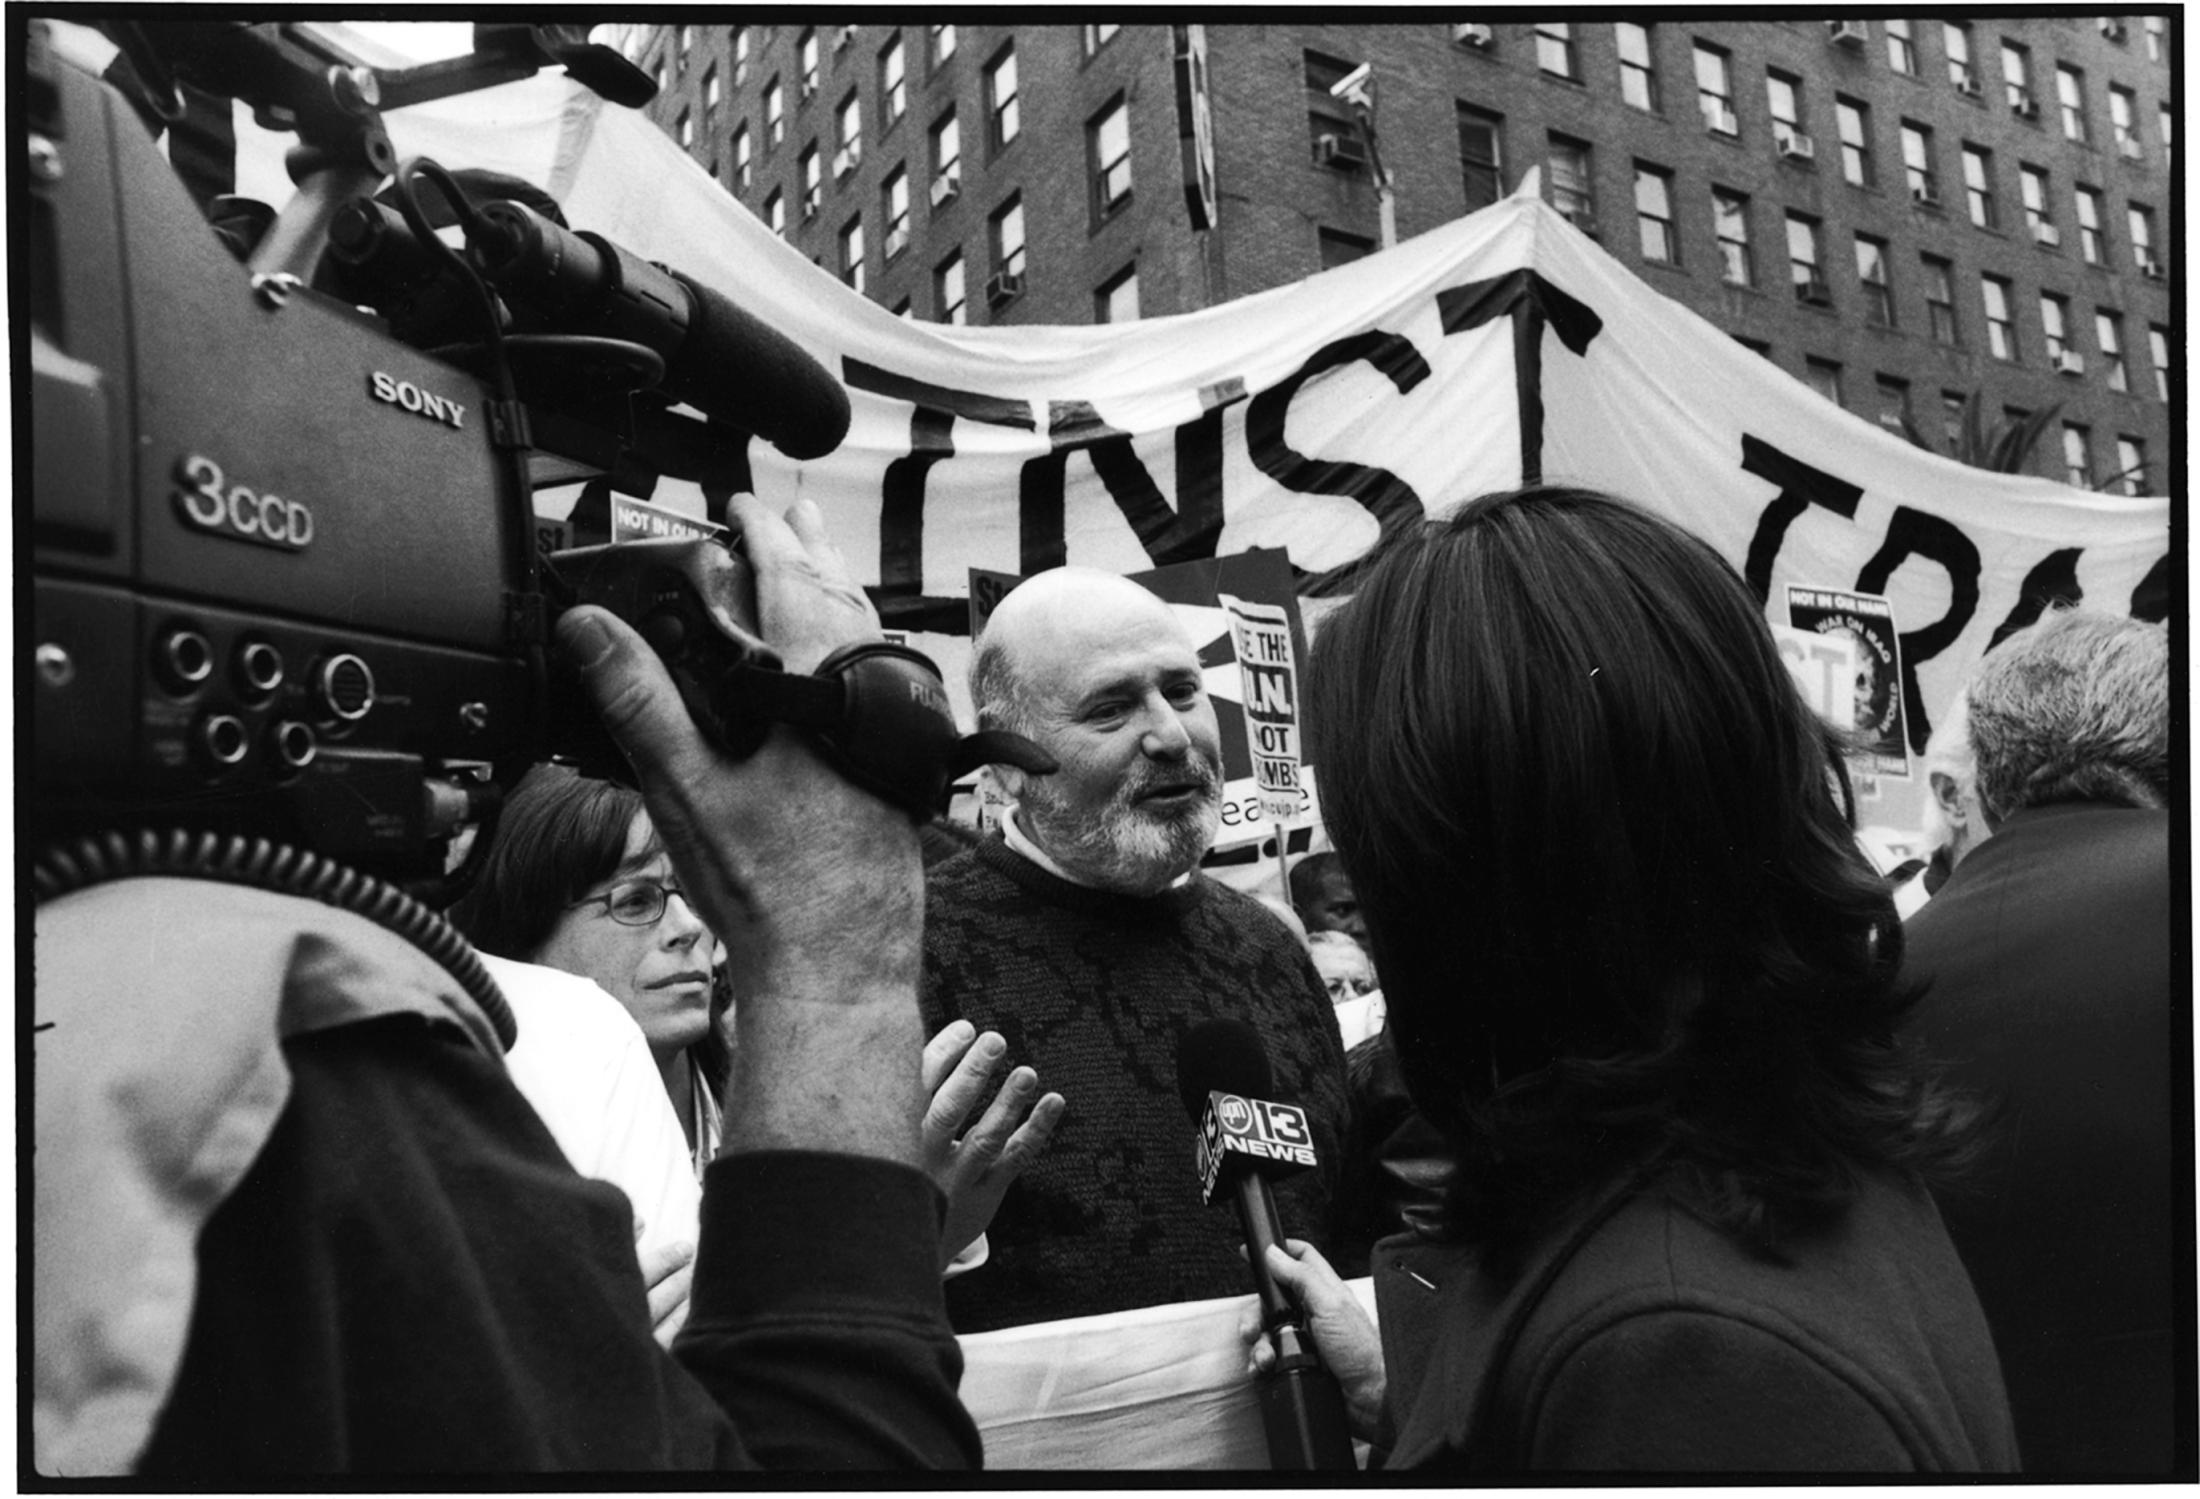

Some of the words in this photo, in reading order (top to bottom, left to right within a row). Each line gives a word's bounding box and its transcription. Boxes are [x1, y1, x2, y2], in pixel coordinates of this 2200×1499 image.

[372, 371, 466, 429] SONY
[182, 455, 314, 546] 3CCD
[617, 506, 649, 531] NOT
[653, 517, 670, 535] IN
[1790, 590, 1815, 606] NOT
[1817, 593, 1832, 608] IN
[1256, 632, 1289, 663] THE
[1814, 614, 1844, 634] WAR
[1846, 615, 1864, 634] ON
[1865, 629, 1892, 664] IRAQ
[1255, 1102, 1310, 1146] 13
[1223, 1134, 1318, 1166] NEWS
